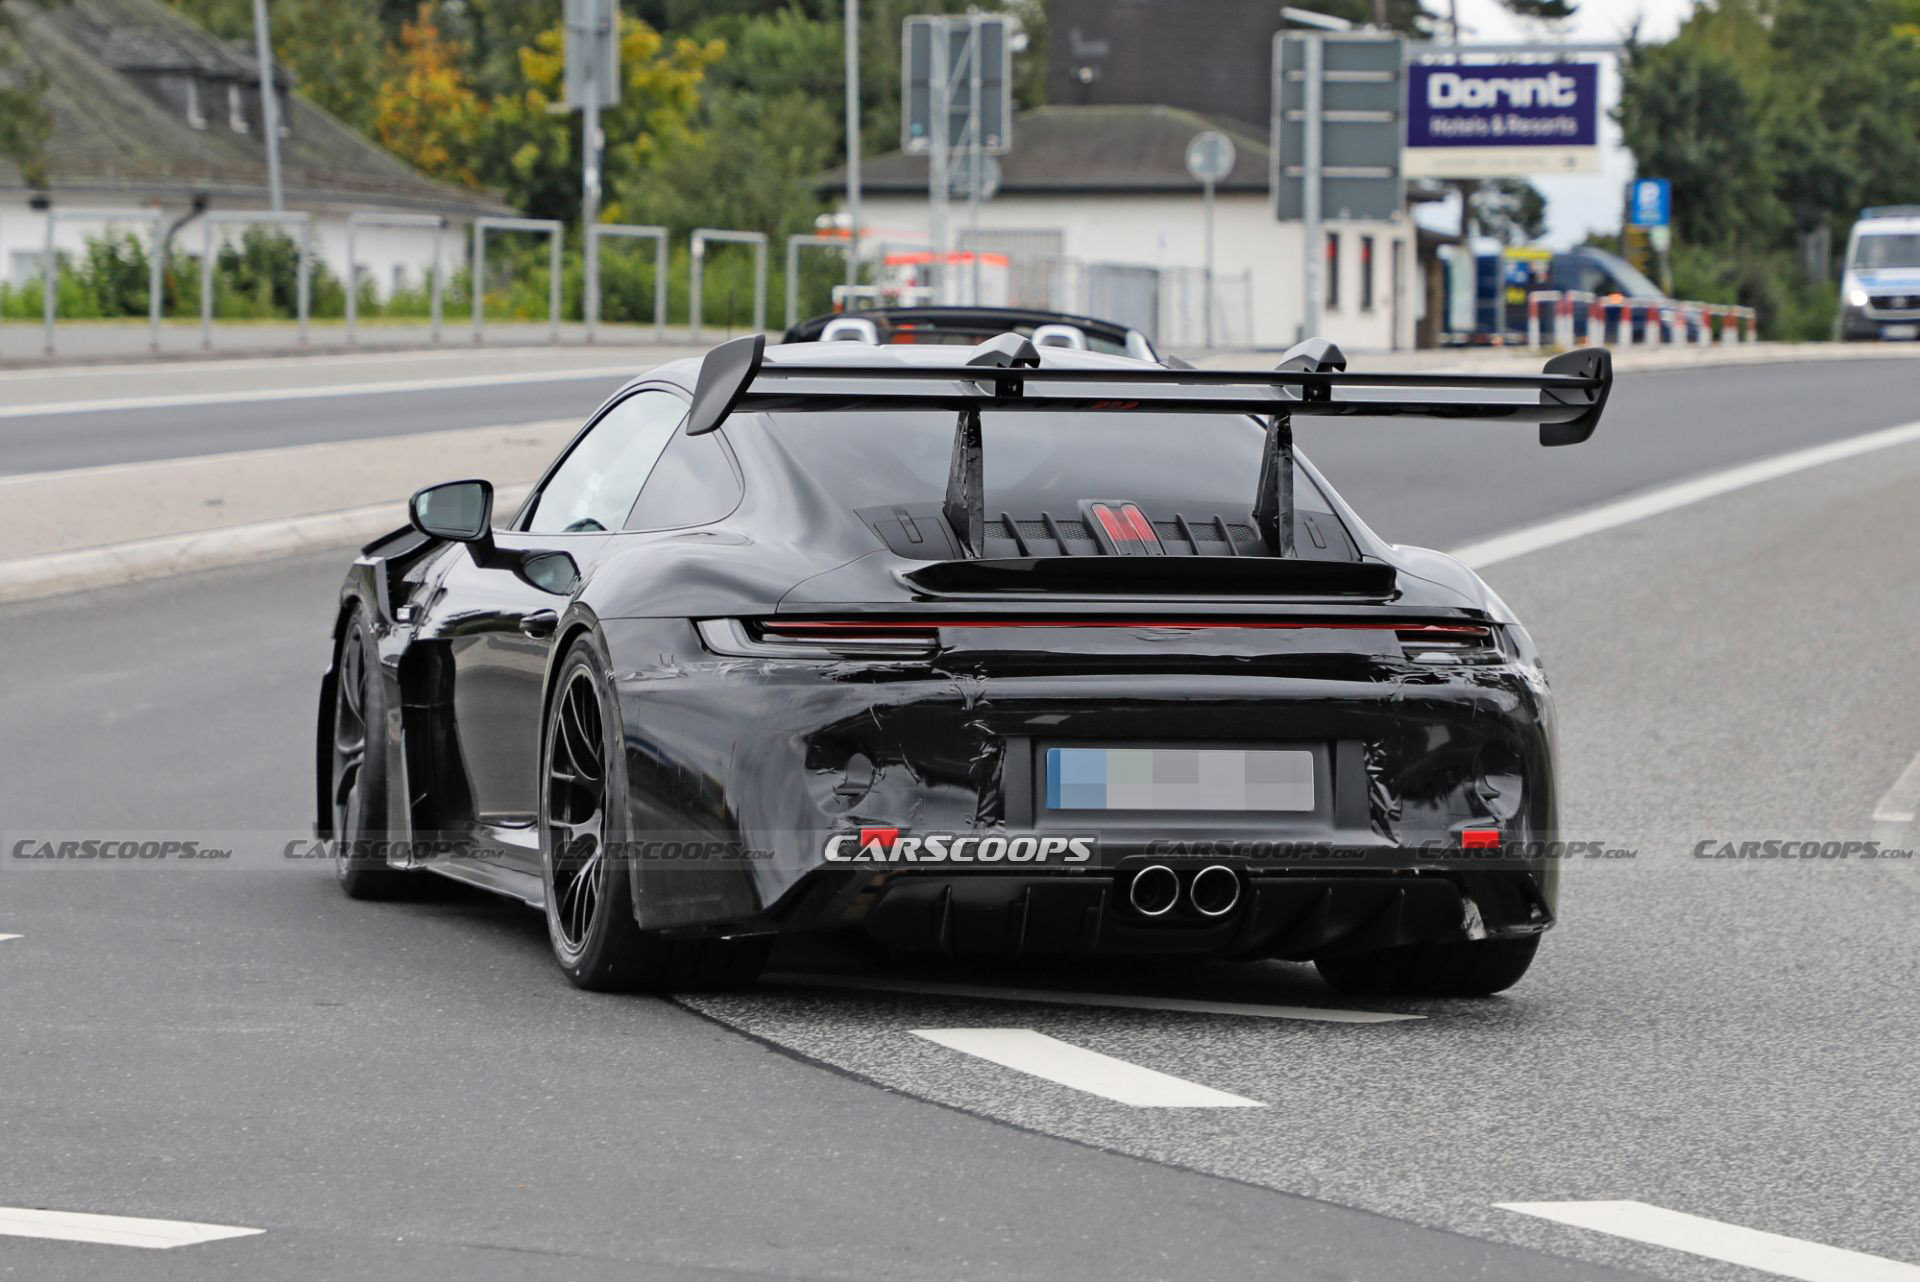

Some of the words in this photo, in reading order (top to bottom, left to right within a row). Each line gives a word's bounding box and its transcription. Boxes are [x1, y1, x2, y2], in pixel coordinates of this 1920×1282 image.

[1427, 71, 1578, 109] Dorint
[1429, 116, 1488, 136] Hotels
[1507, 114, 1578, 136] Resorts
